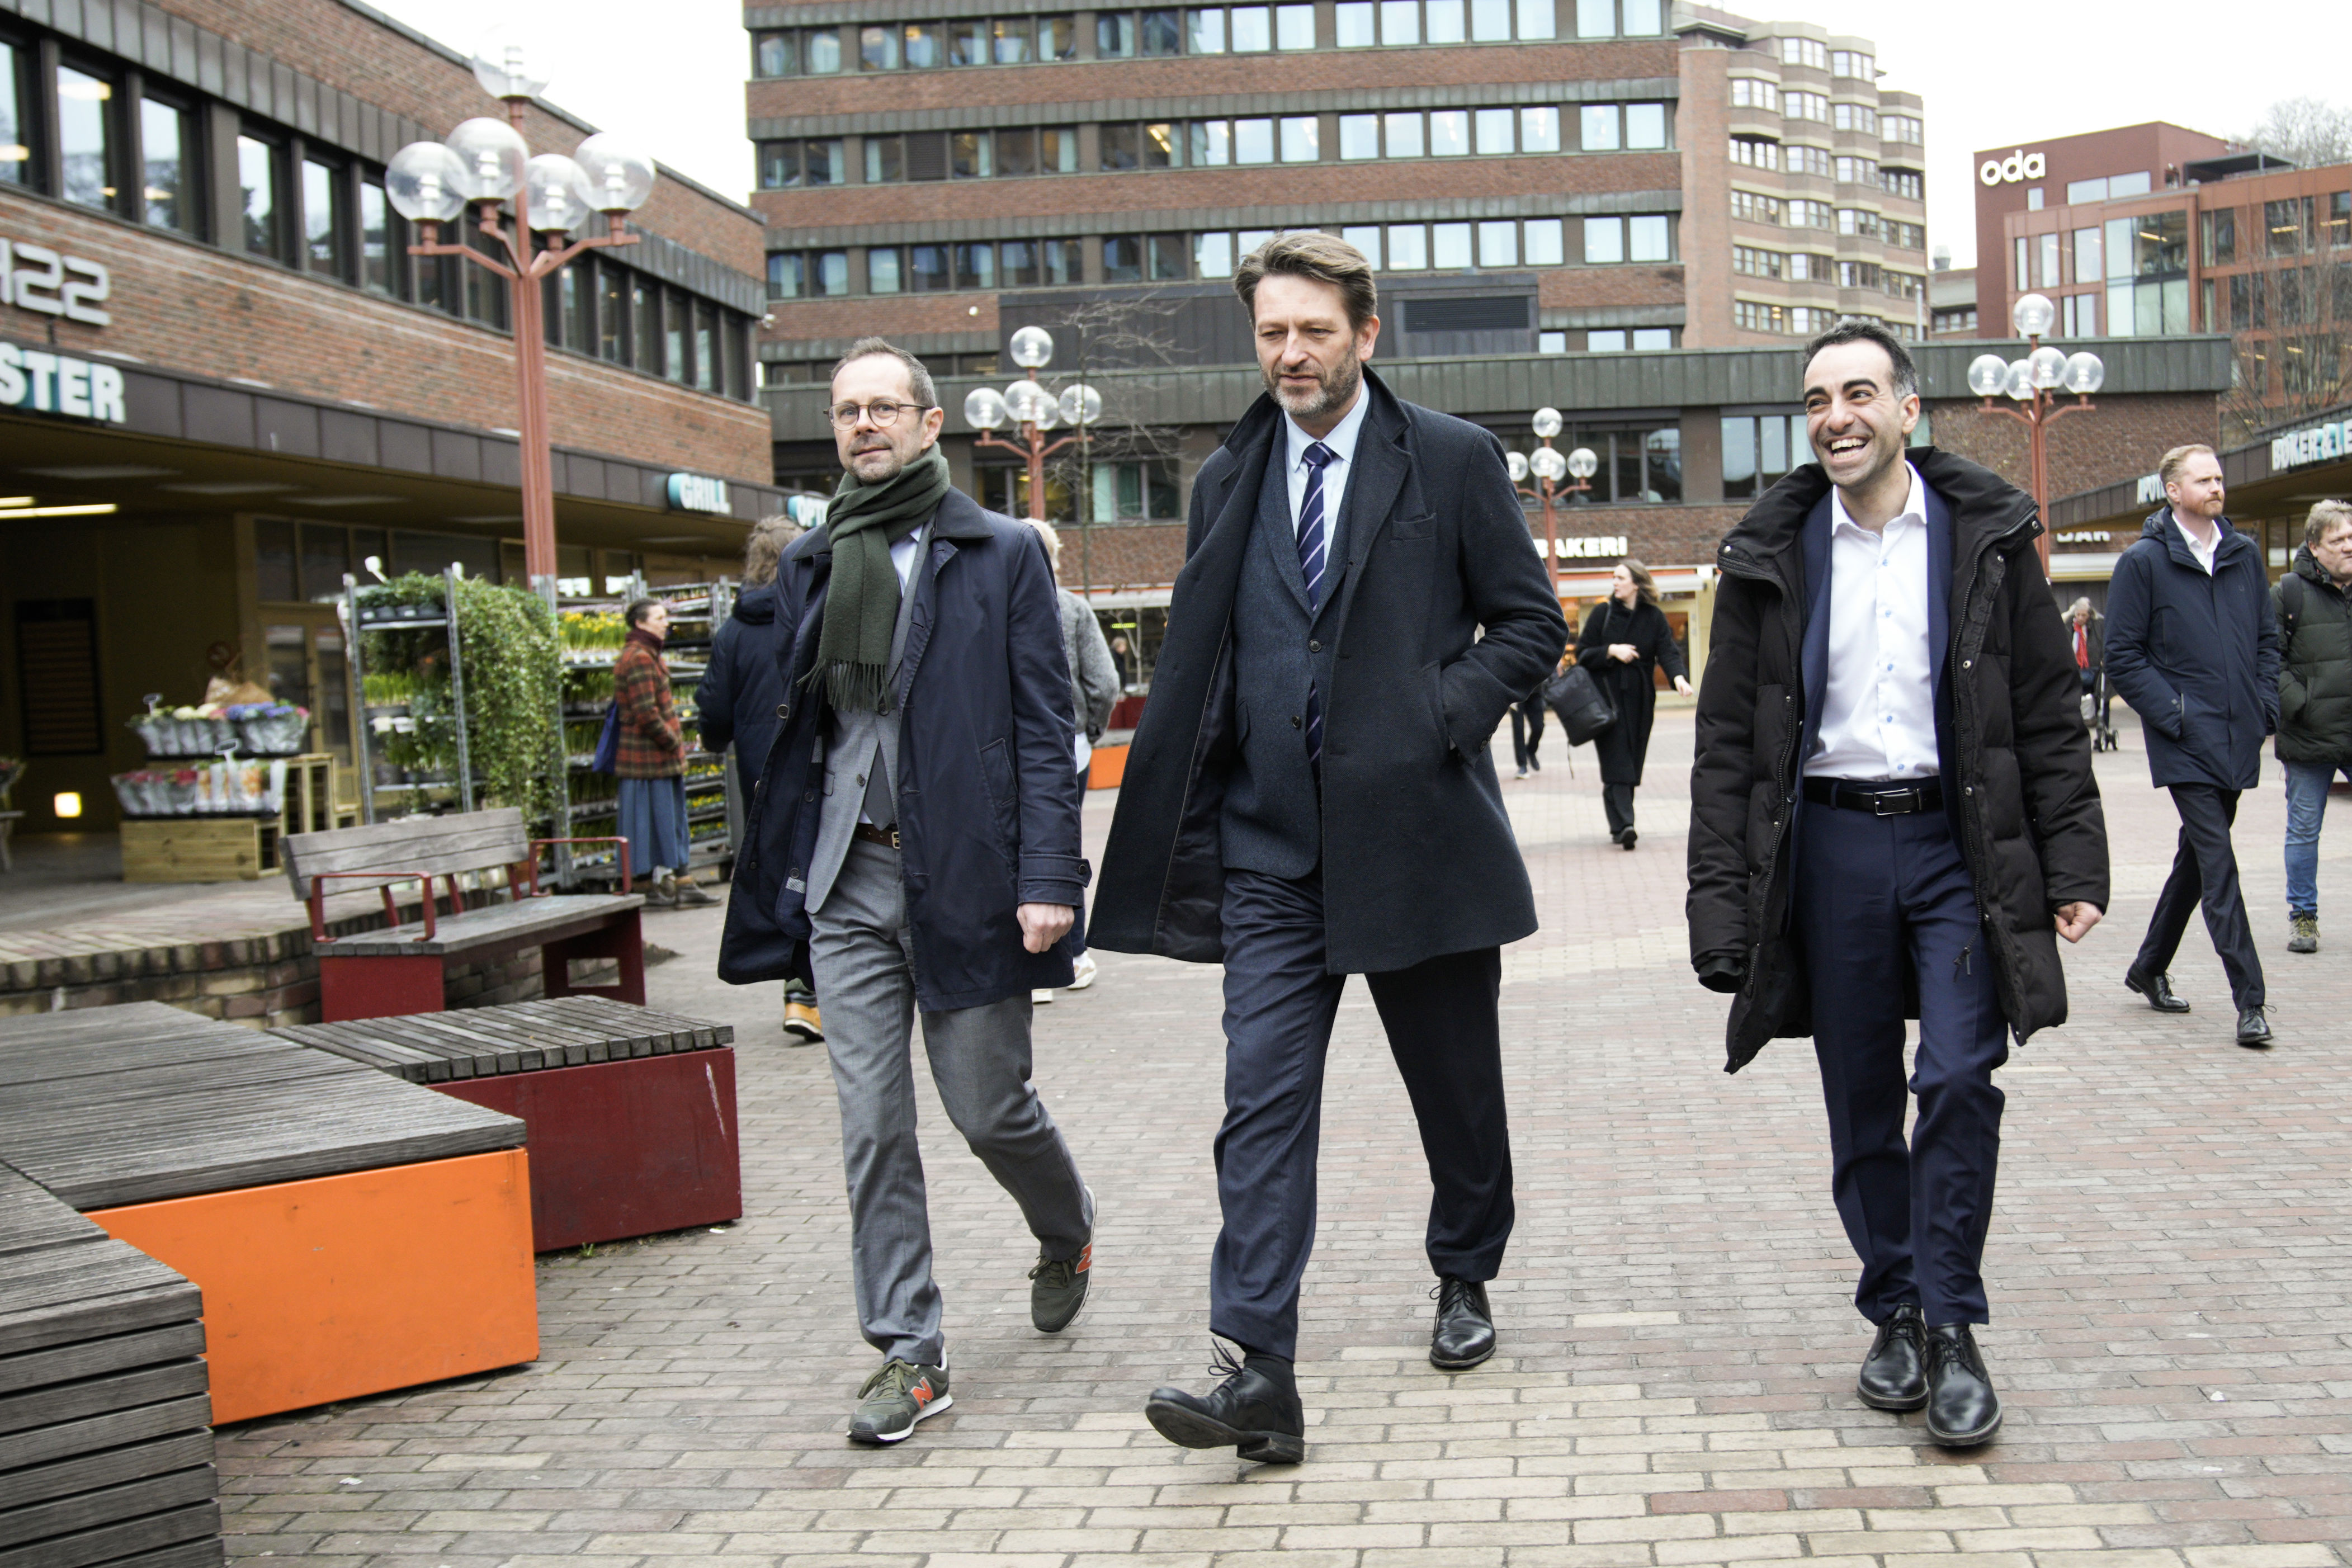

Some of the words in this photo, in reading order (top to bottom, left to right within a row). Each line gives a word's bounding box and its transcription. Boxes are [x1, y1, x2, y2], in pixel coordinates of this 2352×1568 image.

[1980, 149, 2046, 186] oda
[2271, 428, 2319, 471] BØKER
[678, 473, 731, 514] GRILL
